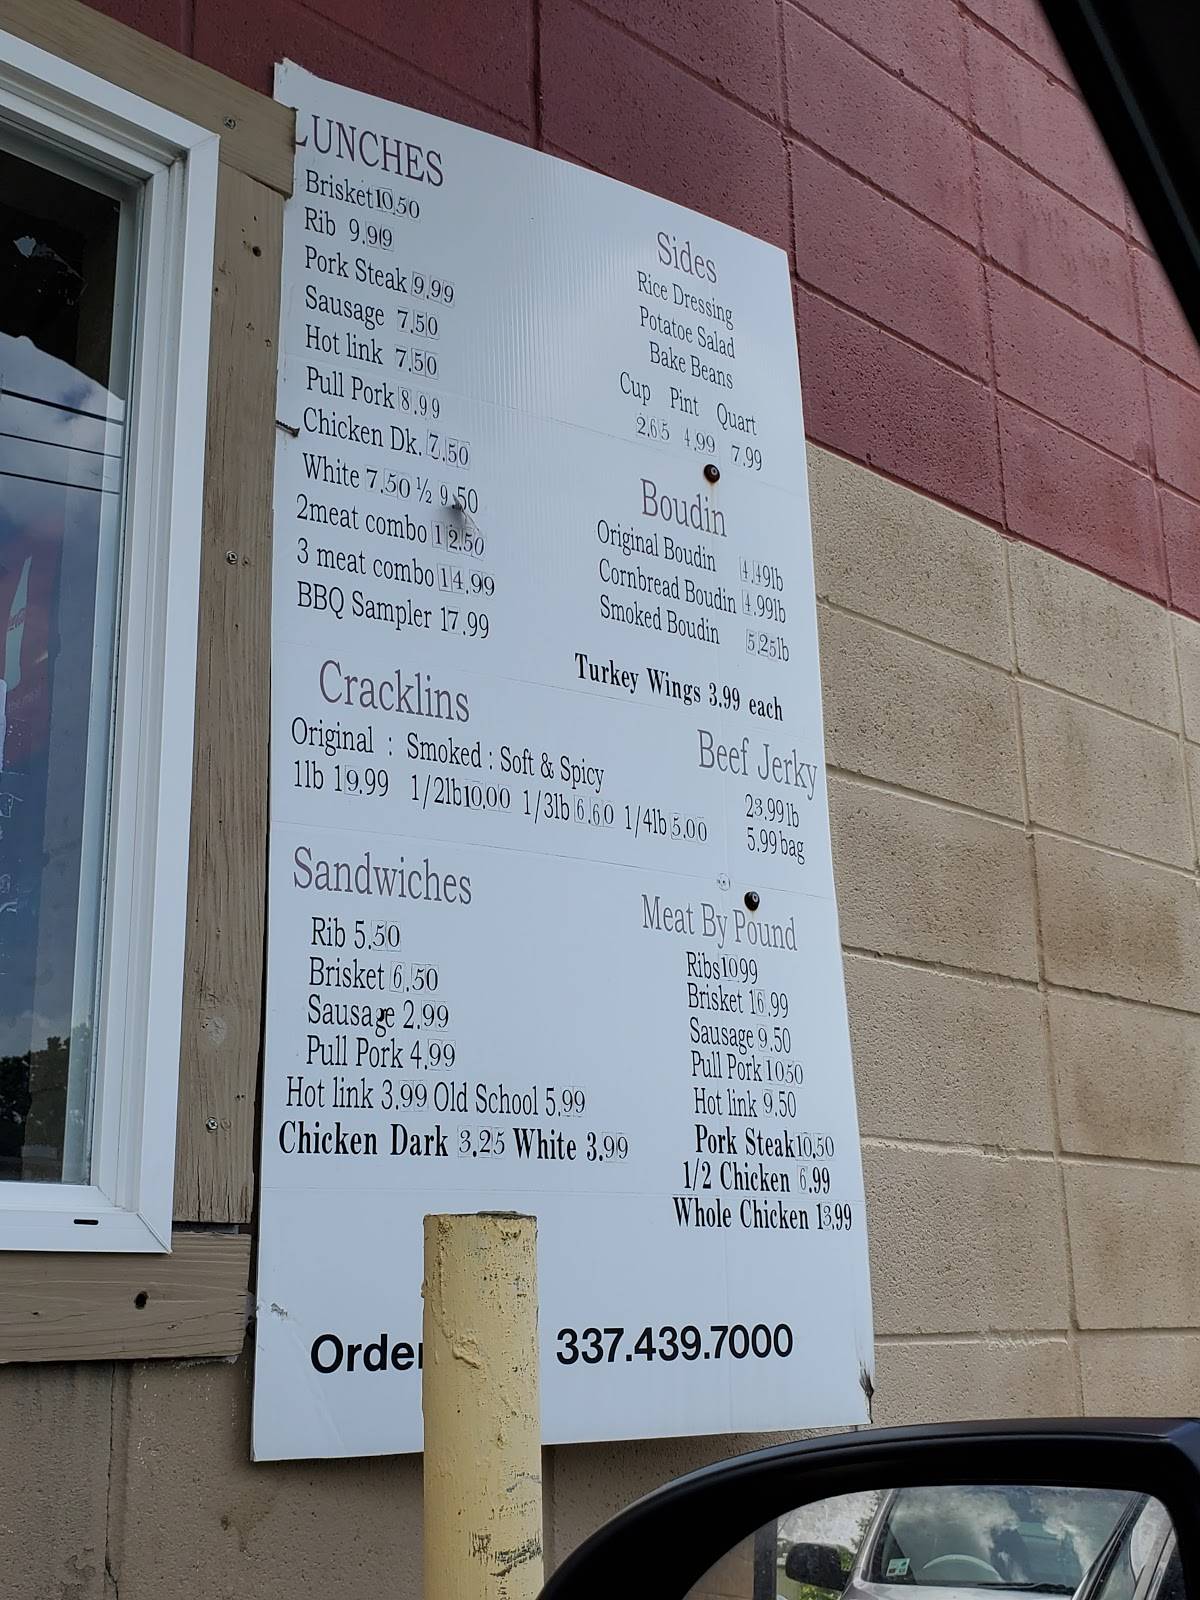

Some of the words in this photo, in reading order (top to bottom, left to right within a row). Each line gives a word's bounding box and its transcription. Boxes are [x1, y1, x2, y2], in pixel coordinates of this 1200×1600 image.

[306, 169, 373, 209] Brisket
[305, 207, 336, 236] Rib
[305, 245, 349, 278] Pork
[355, 258, 407, 293] Steak
[413, 276, 455, 304] 9.99
[657, 232, 717, 283] Sides
[305, 285, 385, 330] Sausage
[397, 310, 438, 336] 7.50
[637, 271, 668, 300] Rice
[673, 283, 734, 330] Dressing
[306, 324, 340, 354] Hot
[347, 332, 383, 365] link
[396, 348, 437, 376] 7.50
[640, 306, 692, 343] Potatoe
[698, 326, 735, 358] Salad
[650, 341, 686, 373] Bake
[691, 355, 733, 389] Beans
[307, 366, 344, 397] Pull
[351, 376, 395, 409] Pork
[401, 389, 440, 419] 8.99
[620, 372, 651, 406] Cup
[670, 387, 699, 416] Pint
[717, 403, 757, 436] Quart
[303, 407, 384, 447] Chicken
[391, 426, 422, 456] Dk.
[303, 453, 360, 488] White
[366, 468, 410, 498] 7.50
[732, 445, 761, 470] 7.99
[366, 515, 427, 543] combo
[640, 478, 727, 537] Boudin
[297, 538, 309, 564] 3
[317, 548, 366, 574] meat
[373, 558, 434, 587] combo
[440, 567, 494, 596] 14.99
[598, 519, 659, 556] Original
[664, 536, 716, 572] Boudin
[297, 581, 344, 619] BBQ
[352, 590, 432, 631] Sampler
[440, 607, 489, 639] 17.99
[600, 558, 680, 599] Cornbread
[685, 579, 737, 614] Boudin
[600, 594, 662, 631] Smoked
[666, 610, 720, 644] Boudin
[319, 660, 469, 722] Cracklins
[575, 652, 639, 694] Turkey
[646, 668, 701, 706] Wings
[709, 682, 740, 711] 3.99
[749, 696, 783, 721] each
[292, 717, 374, 756] Original
[407, 732, 482, 768] Smoked
[500, 746, 534, 776] Soft
[540, 752, 554, 779] &
[560, 756, 604, 793] Spicy
[697, 729, 749, 776] Beef
[758, 744, 817, 800] Jerky
[294, 760, 323, 790] 1lb
[335, 765, 389, 797] 19.99
[523, 790, 569, 824] 1/3lb
[576, 799, 614, 826] 6.60
[625, 806, 666, 838] 1/4lb
[671, 815, 707, 841] 5.00
[293, 846, 472, 905] Sandwiches
[311, 917, 345, 948] Rib
[354, 920, 400, 950] 5.50
[641, 894, 695, 935] Meat
[701, 903, 728, 949] By
[733, 909, 797, 951] Pound
[309, 957, 384, 990] Brisket
[393, 964, 438, 992] 6.50
[686, 952, 720, 981] Ribs
[308, 994, 395, 1037] Sausage
[403, 1000, 449, 1030] 2.99
[687, 983, 743, 1014] Brisket
[749, 990, 788, 1018] 16.99
[306, 1035, 347, 1066] Pull
[356, 1037, 403, 1069] Pork
[410, 1040, 455, 1070] 4.99
[690, 1017, 754, 1055] Sausage
[758, 1027, 791, 1053] 9.50
[691, 1050, 722, 1078] Pull
[727, 1053, 762, 1082] Pork
[286, 1076, 325, 1107] Hot
[332, 1076, 374, 1109] link
[381, 1079, 427, 1110] 3.99
[434, 1081, 468, 1112] Old
[475, 1084, 538, 1115] School
[545, 1088, 585, 1117] 5.99
[694, 1087, 723, 1115] Hot
[727, 1089, 758, 1117] link
[763, 1090, 796, 1118] 9.50
[279, 1120, 377, 1154] Chicken
[390, 1123, 448, 1157] Dark
[459, 1129, 505, 1157] 3.25
[513, 1128, 576, 1160] White
[587, 1132, 628, 1162] 3.99
[695, 1124, 737, 1154] Pork
[745, 1128, 795, 1158] Steak
[683, 1158, 711, 1191] 1/2
[720, 1161, 790, 1192] Chicken
[799, 1167, 830, 1194] 6.99
[672, 1197, 731, 1228] Whole
[740, 1199, 809, 1229] Chicken
[816, 1203, 852, 1230] 13.99
[556, 1323, 794, 1365] 337.439.7000
